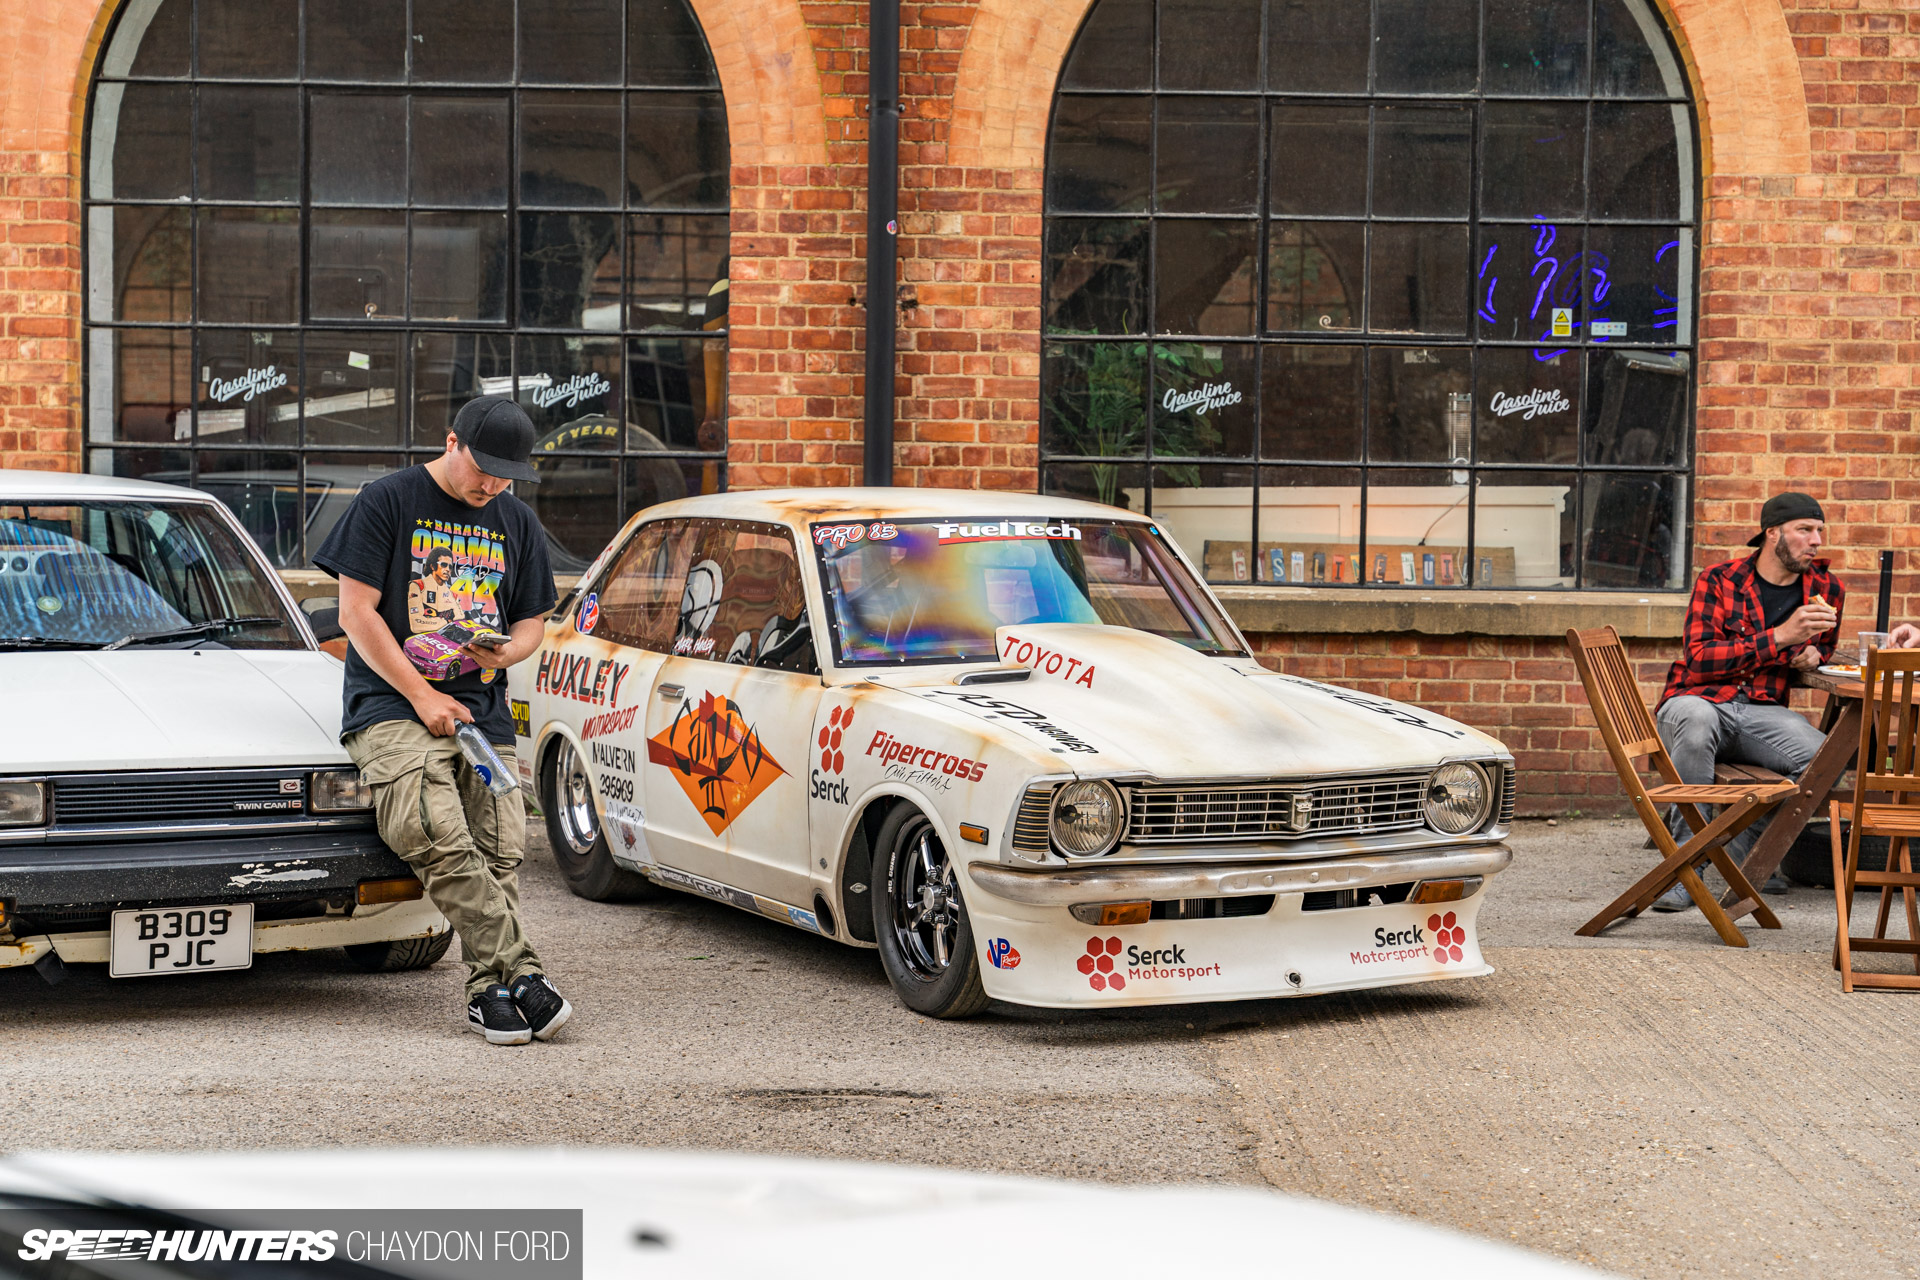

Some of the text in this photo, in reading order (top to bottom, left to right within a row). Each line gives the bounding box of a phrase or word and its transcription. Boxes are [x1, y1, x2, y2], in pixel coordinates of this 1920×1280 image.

[209, 365, 276, 402] Gasoline
[243, 373, 287, 402] Juice
[532, 372, 599, 408] Gasoline
[566, 381, 610, 408] Juice
[1162, 381, 1233, 414] Gasoline
[1197, 388, 1242, 415] Juice
[1490, 388, 1561, 420] Gasoline
[1523, 395, 1570, 420] Juice
[434, 519, 490, 539] BARACK
[813, 523, 898, 549] PRO 85
[932, 521, 1082, 541] FuelTech
[410, 528, 506, 574] OBAMA
[449, 567, 504, 615] 44
[579, 593, 597, 632] VP
[415, 634, 457, 655] ENEOS
[1003, 636, 1096, 688] TOYOTA
[536, 650, 629, 708] HUXLEY
[511, 702, 530, 721] SPUD
[581, 705, 638, 741] MOTORSPORT
[592, 741, 636, 774] MALVERN
[865, 730, 988, 783] Pipercross
[811, 768, 849, 805] Serck
[905, 769, 952, 795] Filters
[287, 800, 302, 808] 16
[138, 908, 229, 941] B309
[1374, 924, 1424, 948] Serck
[149, 939, 216, 970] PJC
[987, 937, 1011, 968] VP
[1127, 944, 1185, 966] Serck
[1350, 945, 1429, 965] Motorsport
[1128, 964, 1221, 983] Motorsport
